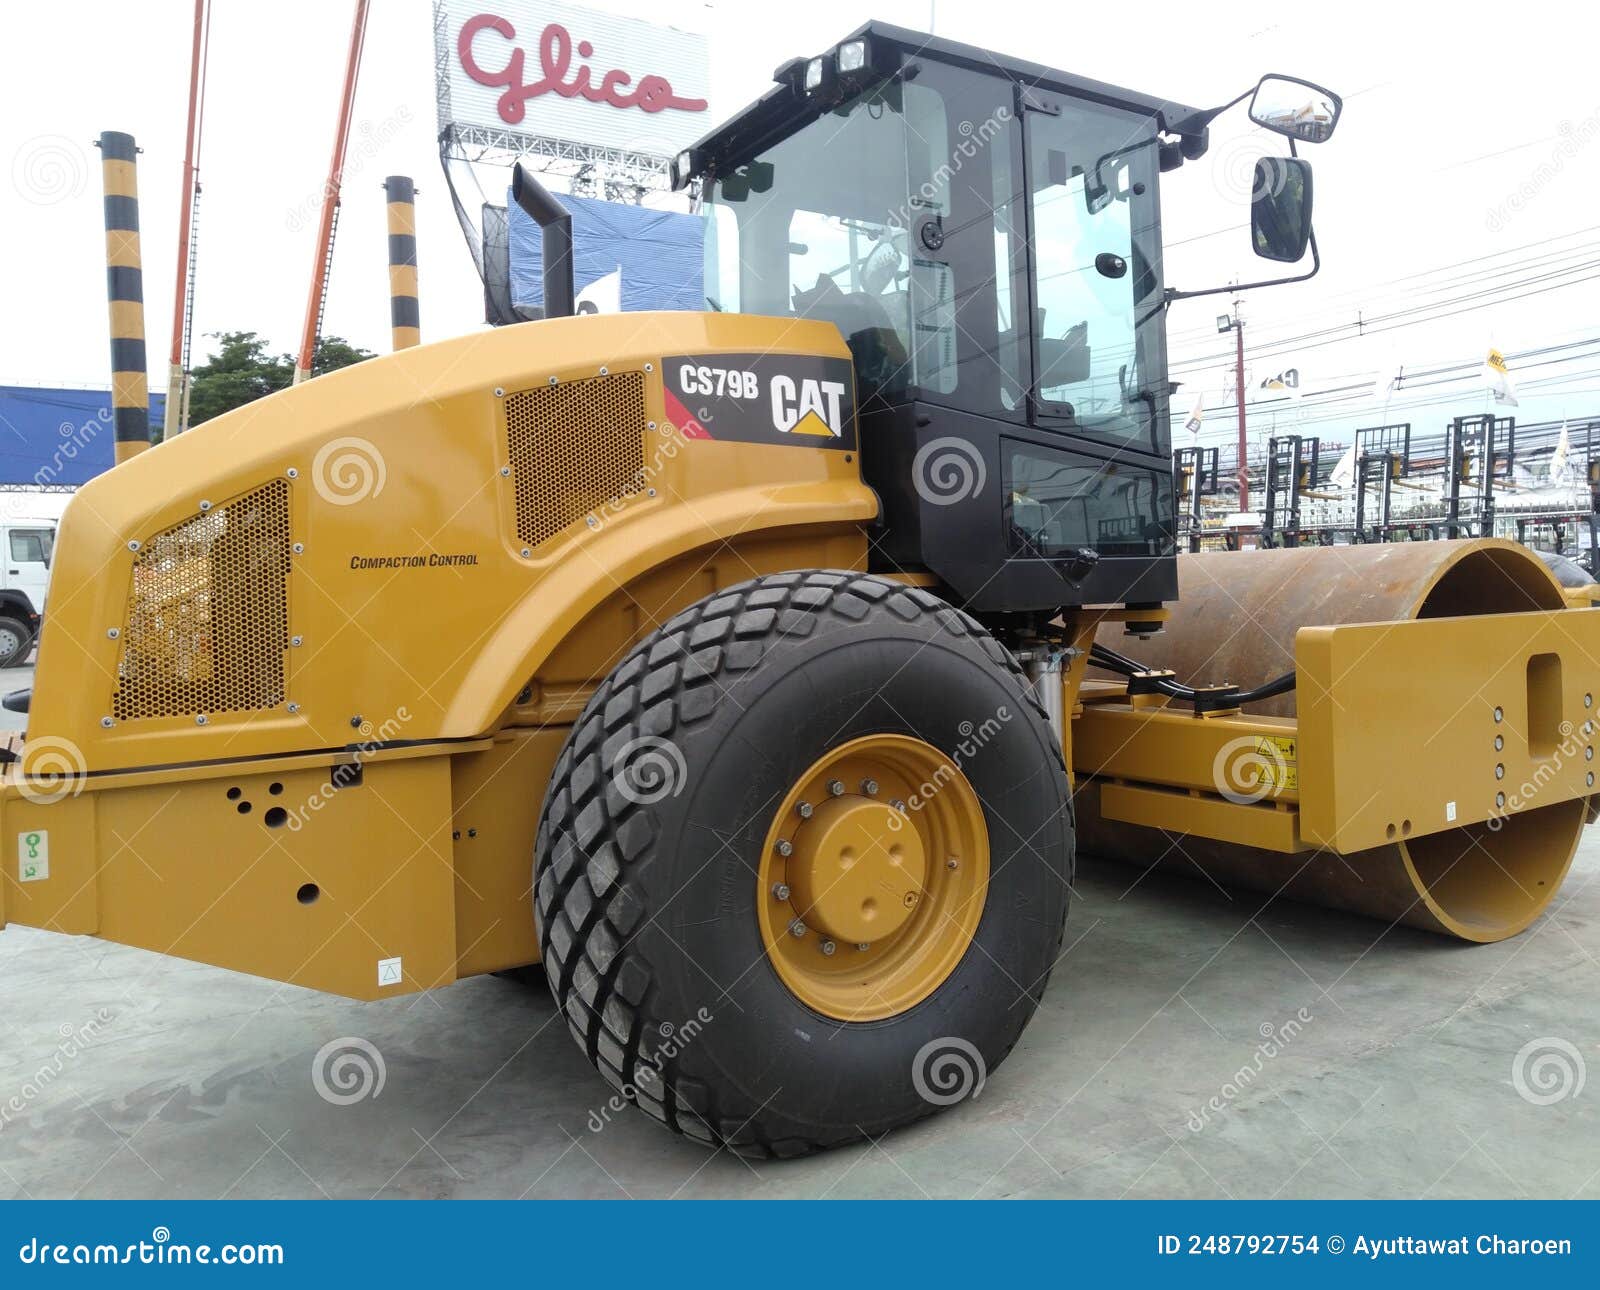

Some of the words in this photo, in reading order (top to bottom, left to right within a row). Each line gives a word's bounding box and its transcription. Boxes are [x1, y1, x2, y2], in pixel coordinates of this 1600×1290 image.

[457, 14, 708, 123] Glico
[680, 364, 759, 399] CS79B
[770, 375, 845, 437] CAT
[350, 556, 426, 570] COMPACTION
[429, 553, 479, 567] CONTROL
